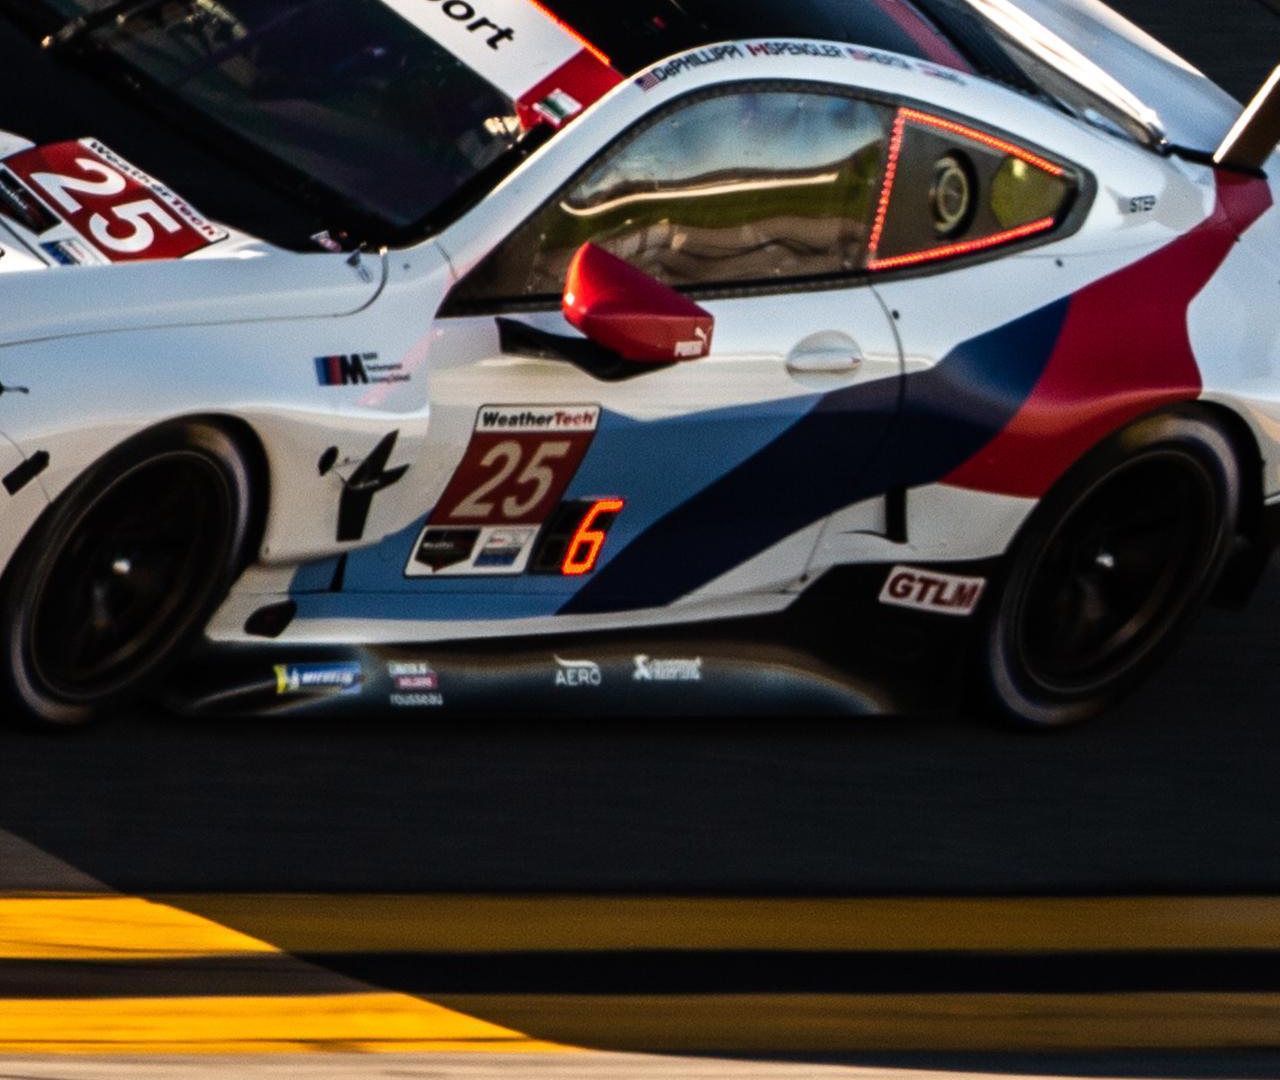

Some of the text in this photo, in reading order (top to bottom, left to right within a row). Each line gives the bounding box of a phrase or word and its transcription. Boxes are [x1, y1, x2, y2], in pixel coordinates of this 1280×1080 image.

[767, 40, 847, 59] SPENGLER
[29, 157, 183, 253] 25
[482, 411, 595, 427] WeatherTech
[449, 440, 571, 518] 25
[561, 496, 625, 576] 6
[888, 572, 980, 609] GTLM
[555, 669, 602, 686] AERO
